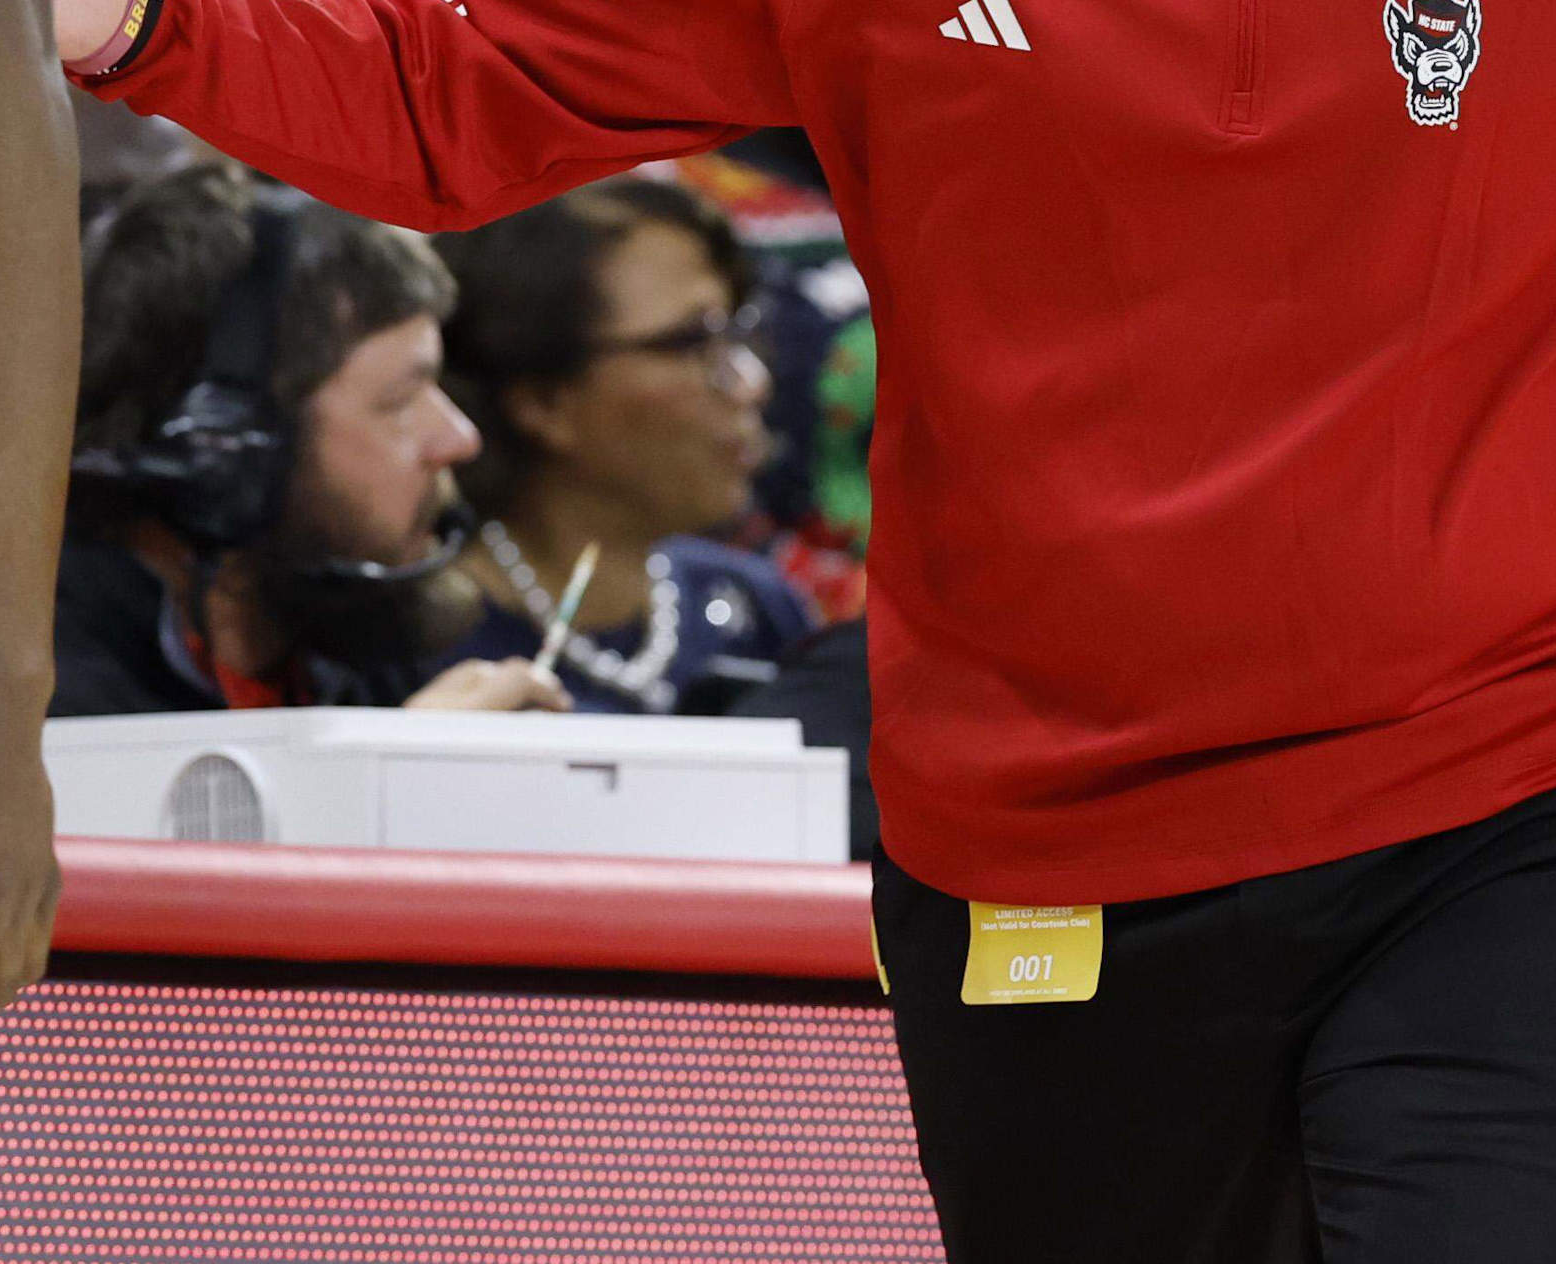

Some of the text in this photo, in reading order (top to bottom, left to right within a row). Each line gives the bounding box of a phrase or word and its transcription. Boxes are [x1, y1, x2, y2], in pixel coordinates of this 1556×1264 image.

[1417, 13, 1457, 33] NC STATE
[995, 907, 1074, 920] LIMITED ACCESS
[1009, 954, 1053, 983] 001
